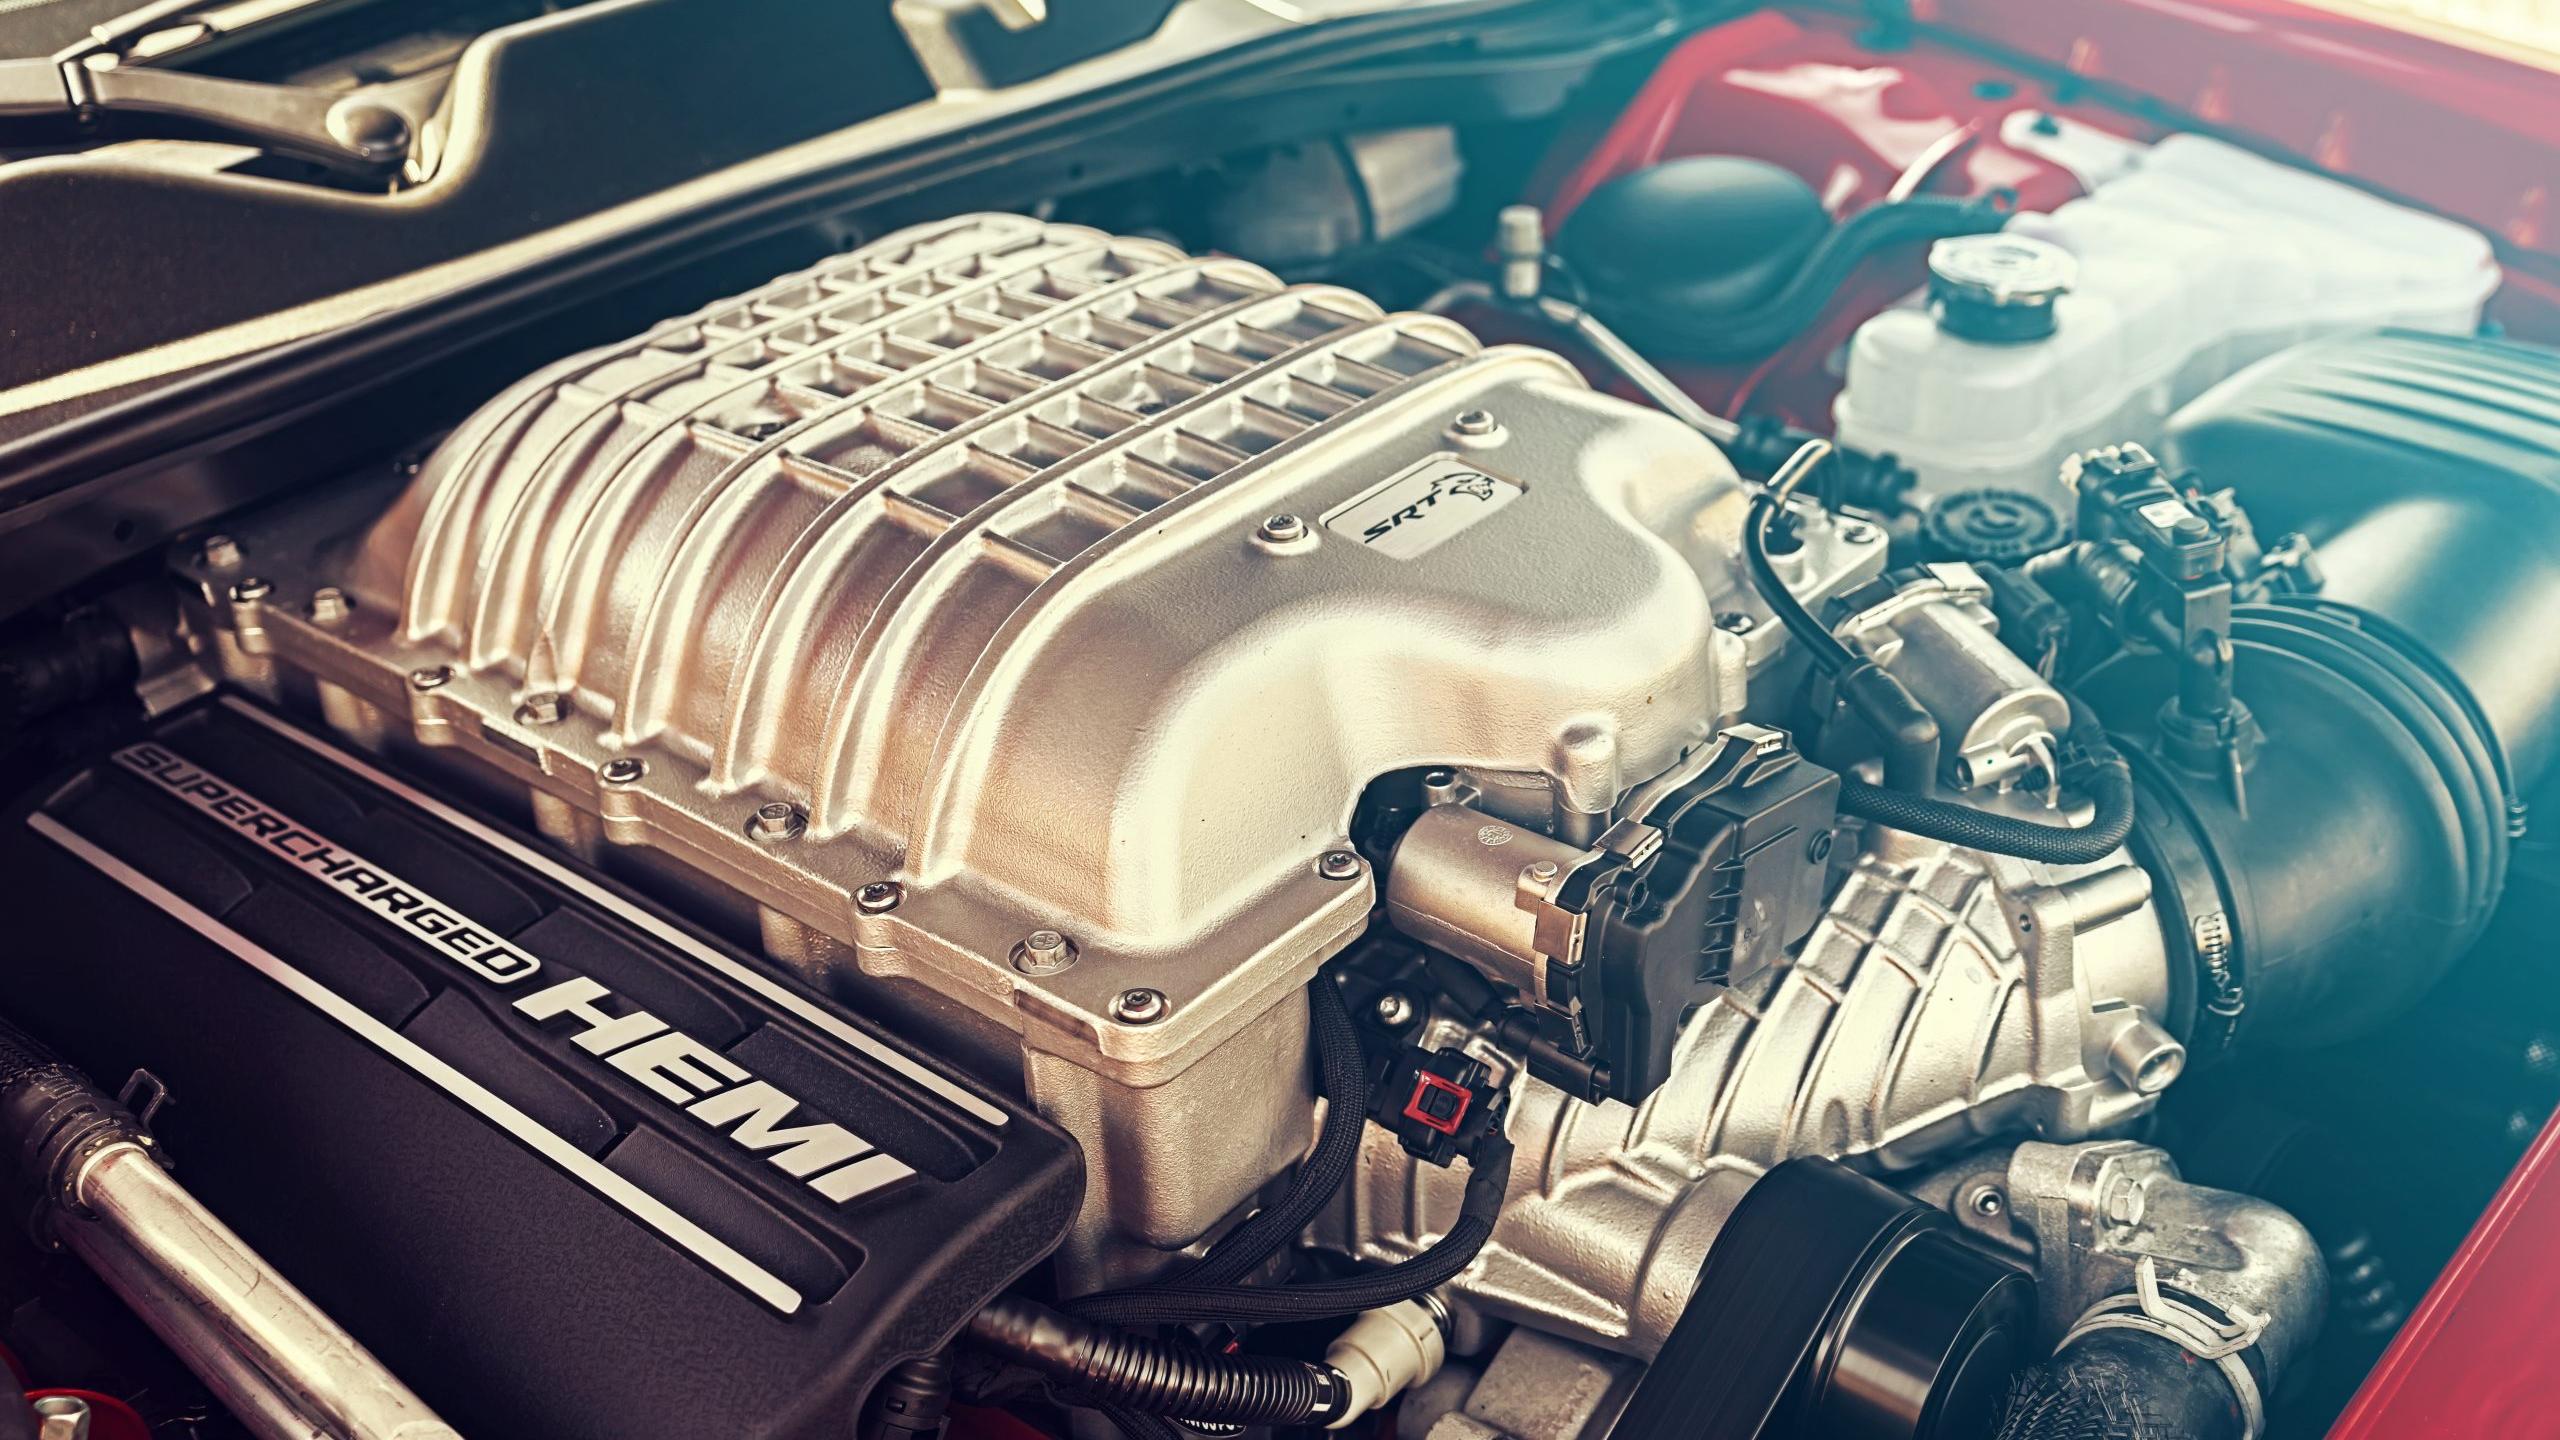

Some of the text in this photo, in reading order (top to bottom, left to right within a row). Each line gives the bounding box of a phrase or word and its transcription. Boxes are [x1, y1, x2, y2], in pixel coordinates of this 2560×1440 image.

[1363, 488, 1442, 544] SRT
[122, 745, 918, 1206] SUPERCHARGED HEMI
